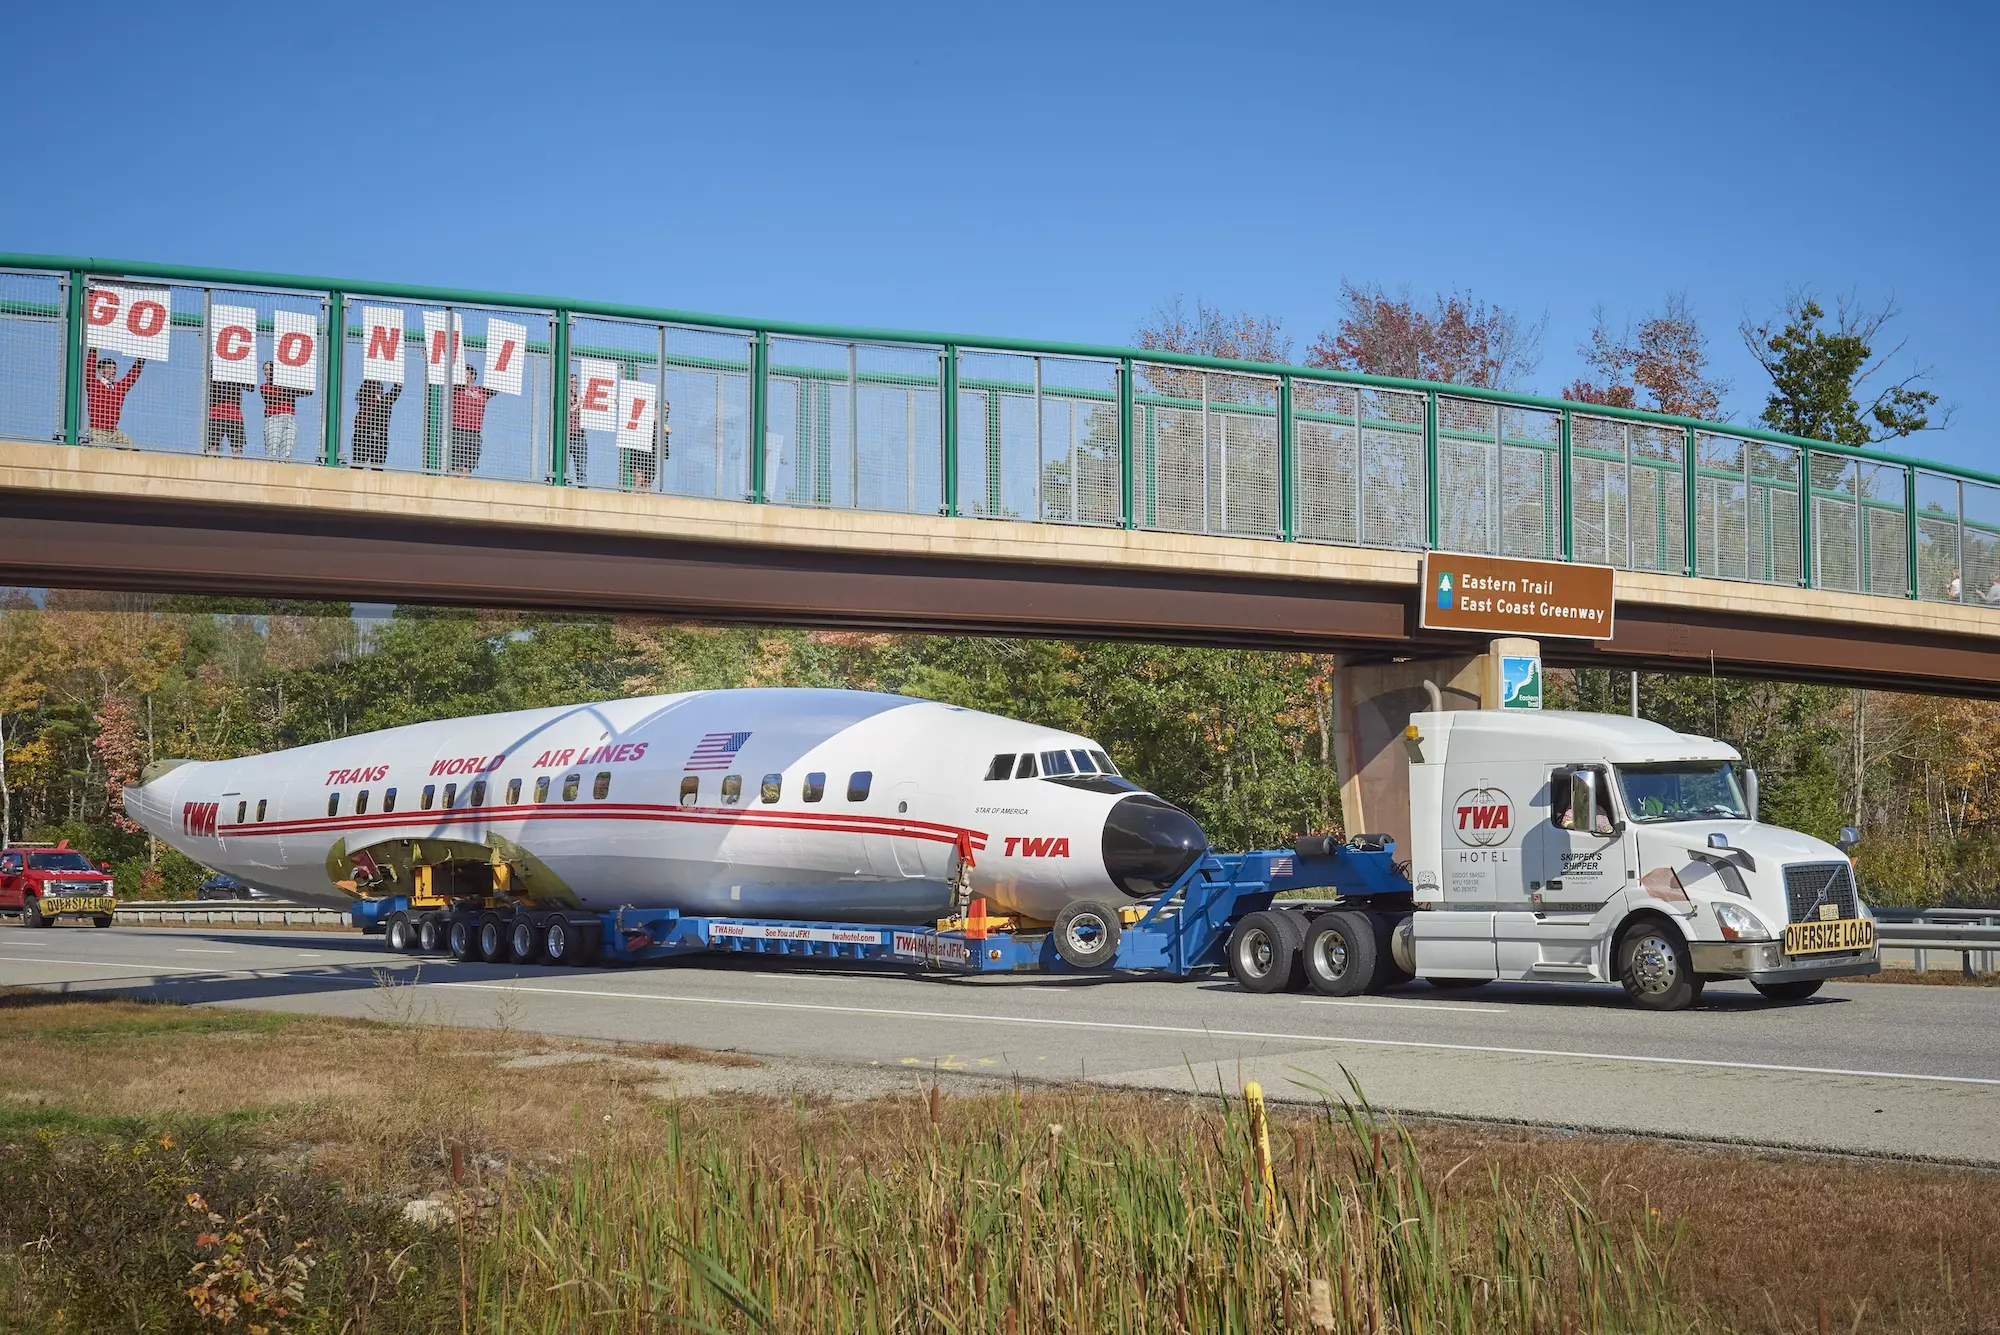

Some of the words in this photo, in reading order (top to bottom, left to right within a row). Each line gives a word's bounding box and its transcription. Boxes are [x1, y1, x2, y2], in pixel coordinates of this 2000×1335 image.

[88, 289, 167, 337] GO
[1461, 574, 1516, 593] Eastern
[1521, 578, 1553, 595] Trail
[1460, 596, 1492, 613] East
[1496, 599, 1535, 616] Coast
[1540, 602, 1605, 624] Greenway
[325, 764, 390, 786] TRANS
[429, 754, 507, 777] WORLD
[533, 748, 577, 769] AIR
[577, 742, 649, 766] LINES
[183, 801, 219, 838] TWA
[1456, 805, 1509, 830] TWA
[1004, 837, 1070, 858] TWA
[1460, 851, 1508, 863] HOTEL
[1560, 852, 1602, 861] SKIPPER'S
[1563, 862, 1598, 870] SHIPPER
[714, 925, 728, 934] TWA
[728, 926, 744, 935] Hotel
[765, 928, 777, 937] See
[777, 928, 788, 937] You
[795, 930, 810, 939] JFK!
[832, 933, 875, 943] twahotel.com
[1786, 924, 1840, 951] OVERSIZE
[1844, 922, 1872, 946] LOAD
[896, 936, 917, 951] TWA
[918, 938, 937, 955] Hote
[939, 944, 946, 956] at
[946, 942, 962, 959] JFK
